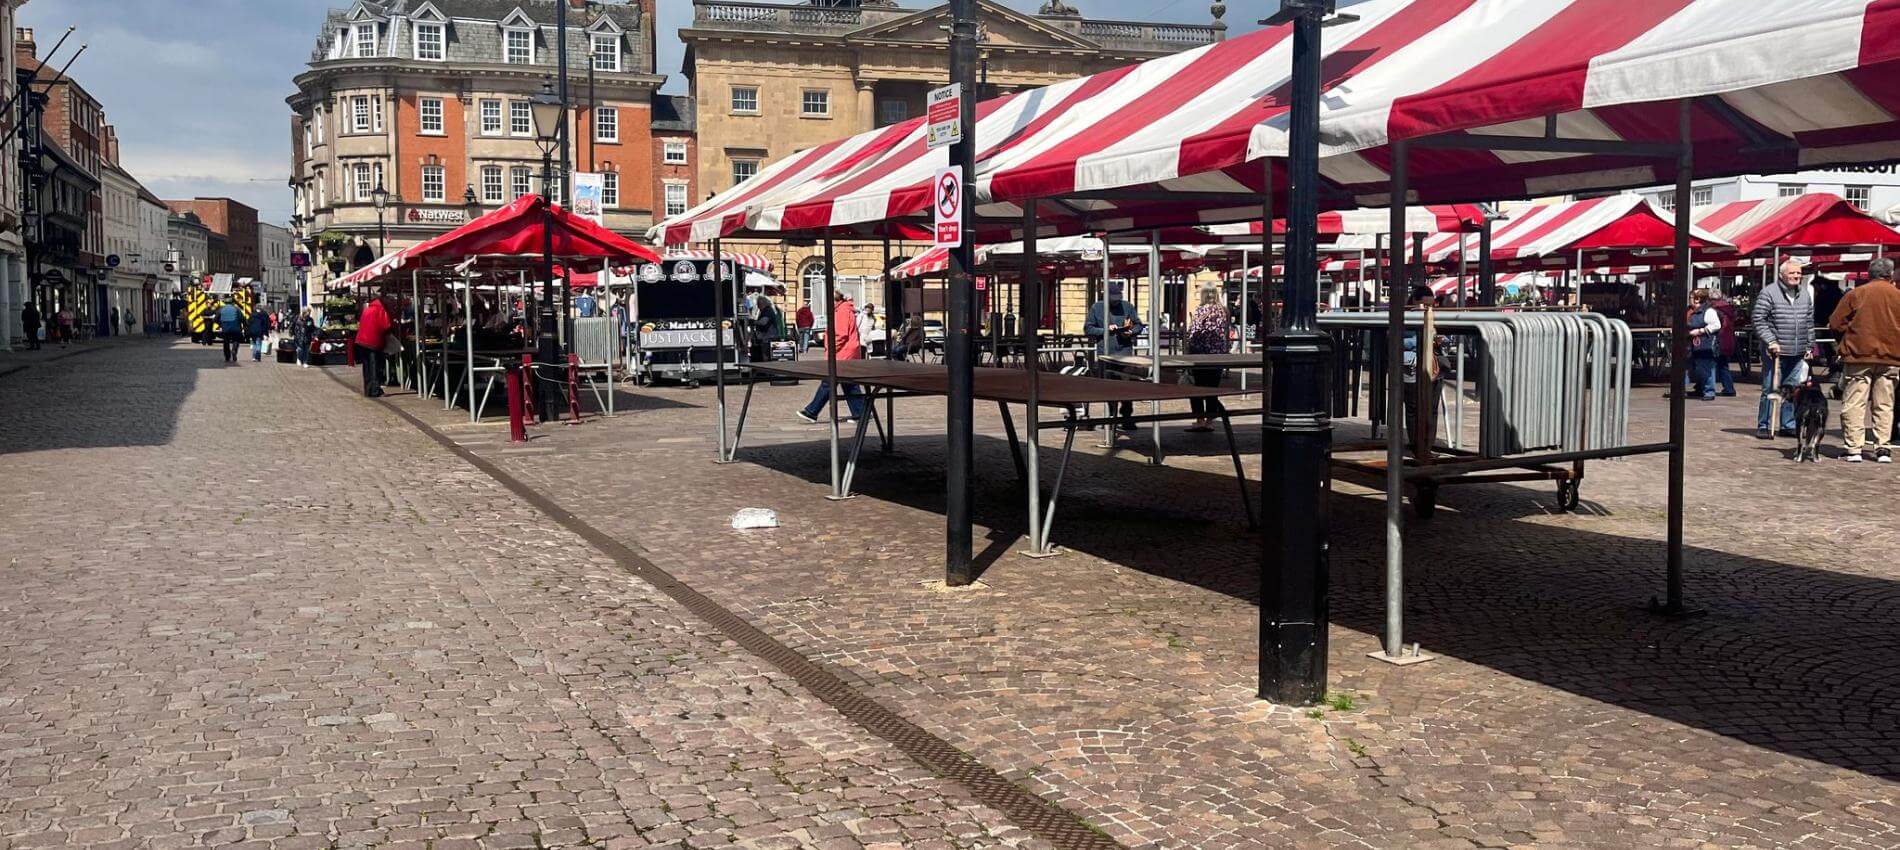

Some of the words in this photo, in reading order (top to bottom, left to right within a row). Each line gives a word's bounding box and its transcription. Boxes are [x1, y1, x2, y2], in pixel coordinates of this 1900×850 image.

[934, 88, 953, 101] NOTICE
[419, 208, 466, 220] NatWest
[669, 320, 704, 330] Maria's
[643, 332, 673, 346] JUST
[678, 331, 731, 345] JACKES
